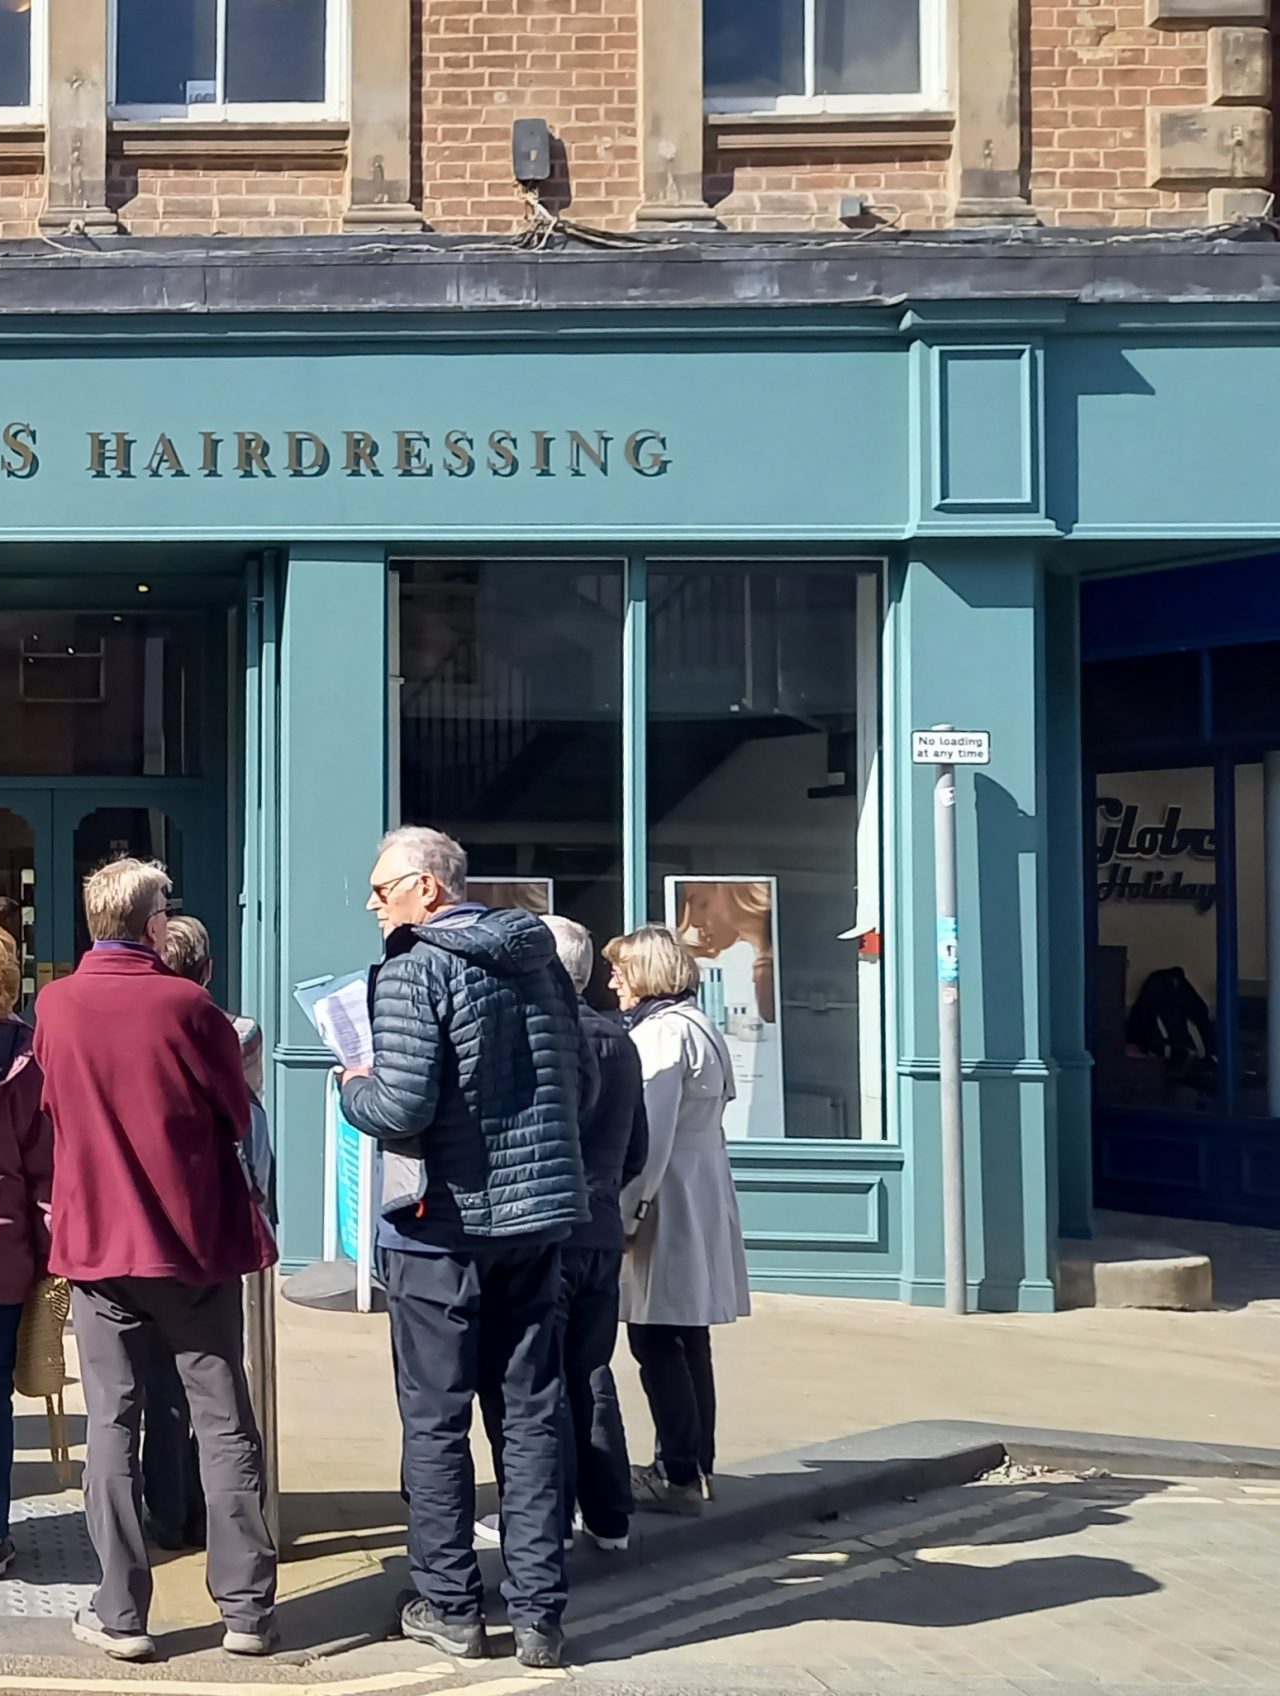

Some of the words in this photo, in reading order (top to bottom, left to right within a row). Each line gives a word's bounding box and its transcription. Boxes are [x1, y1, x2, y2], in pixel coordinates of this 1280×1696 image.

[85, 429, 673, 478] HAIRDRESSING
[918, 736, 936, 746] No
[939, 736, 983, 748] loading
[917, 749, 929, 758] at
[933, 750, 954, 760] any
[958, 749, 984, 758] time
